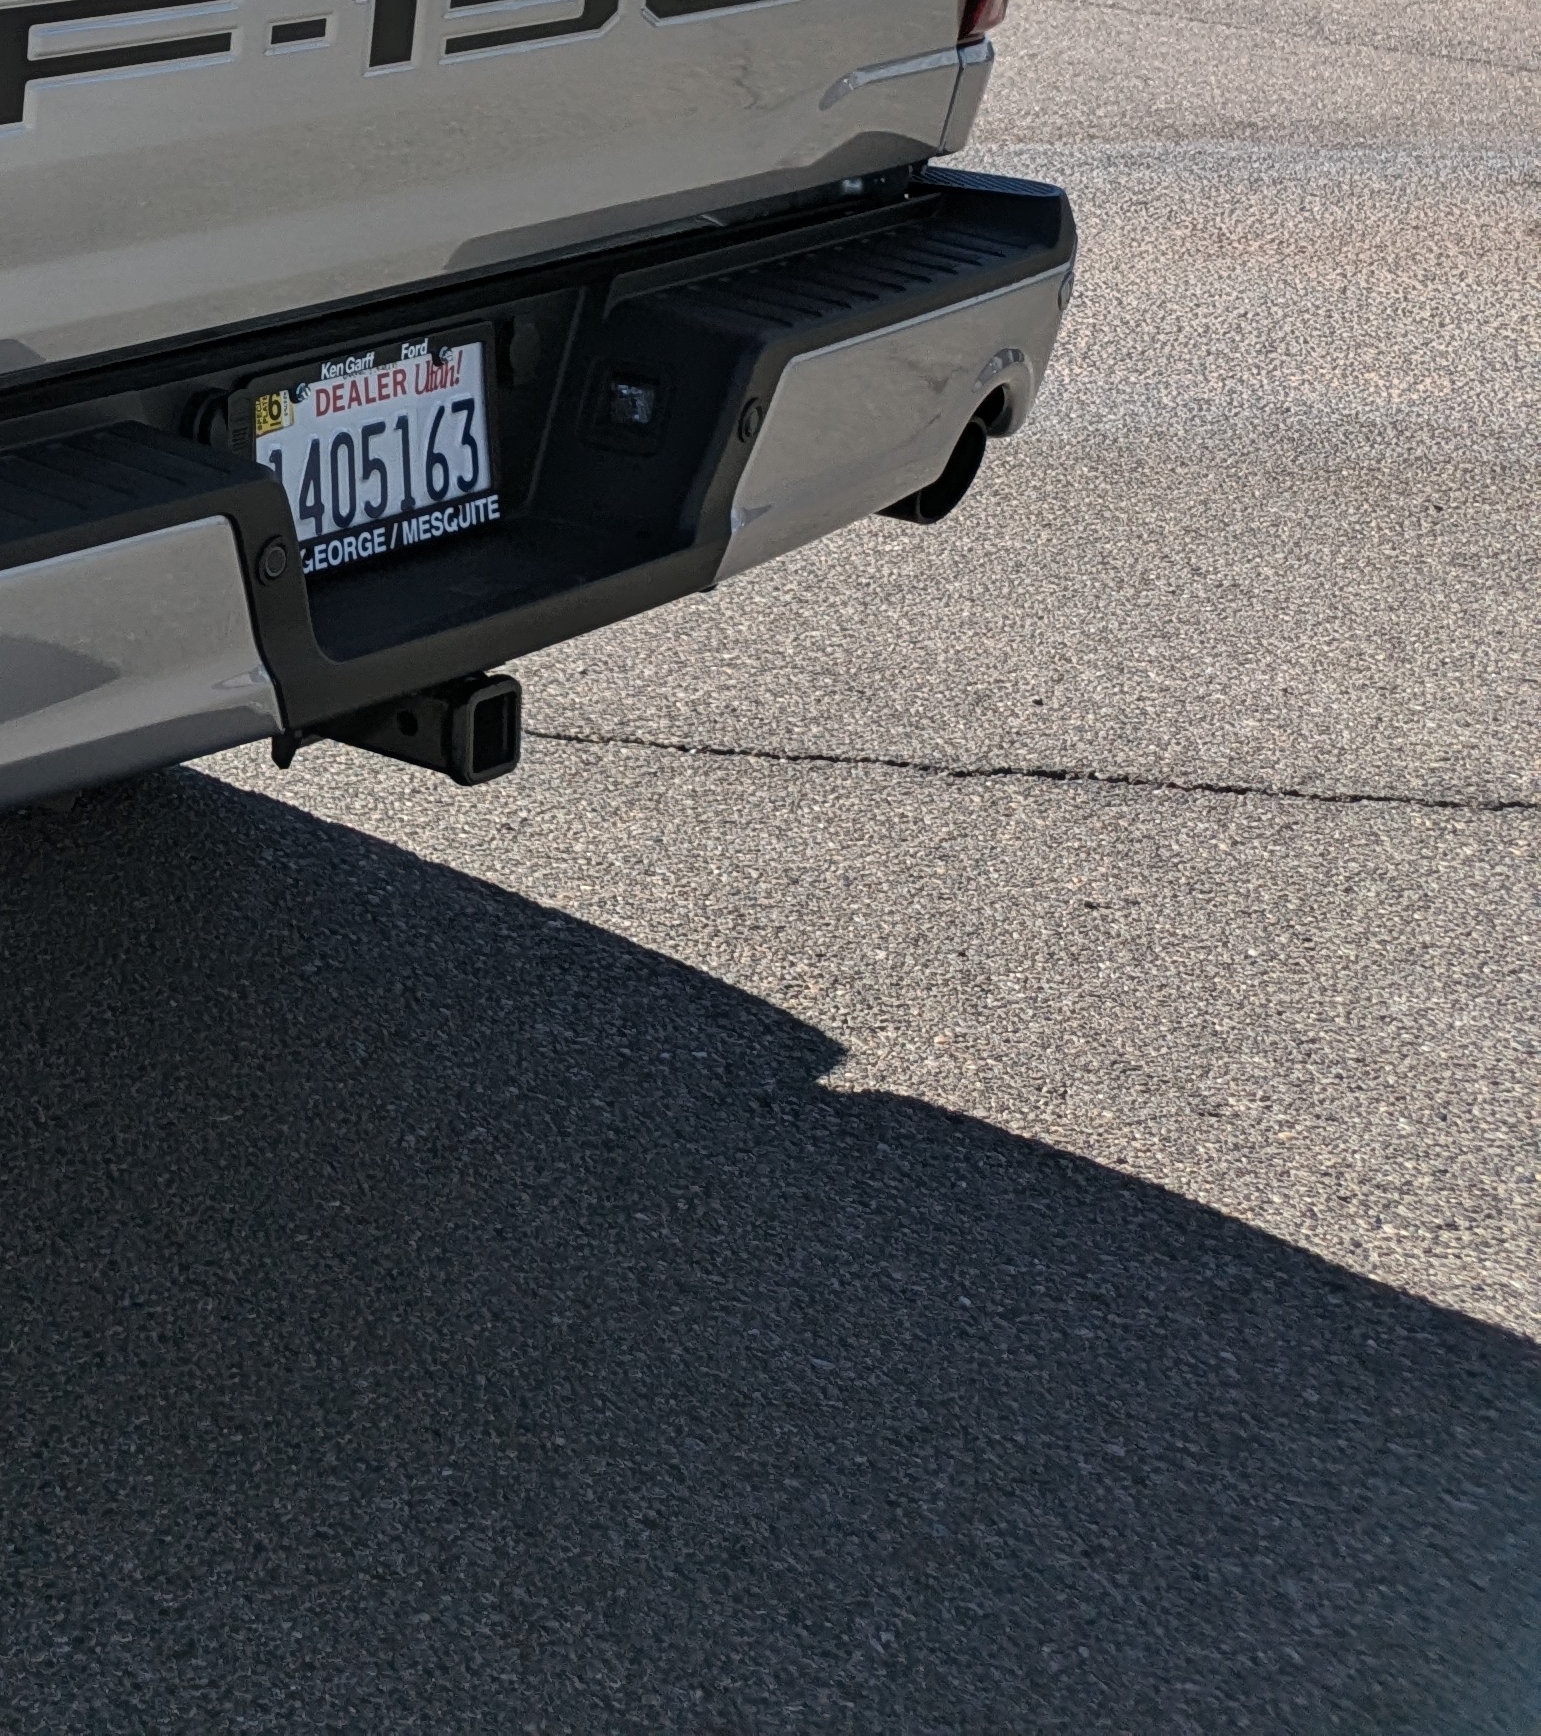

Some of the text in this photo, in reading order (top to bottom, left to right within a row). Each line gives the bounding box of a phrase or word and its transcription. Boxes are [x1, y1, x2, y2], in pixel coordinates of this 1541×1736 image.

[315, 366, 408, 418] DEALER
[414, 349, 464, 397] Utah!
[321, 361, 344, 380] Ken
[345, 350, 376, 373] Garff
[400, 338, 429, 360] Ford
[402, 494, 501, 545] MESQUITE
